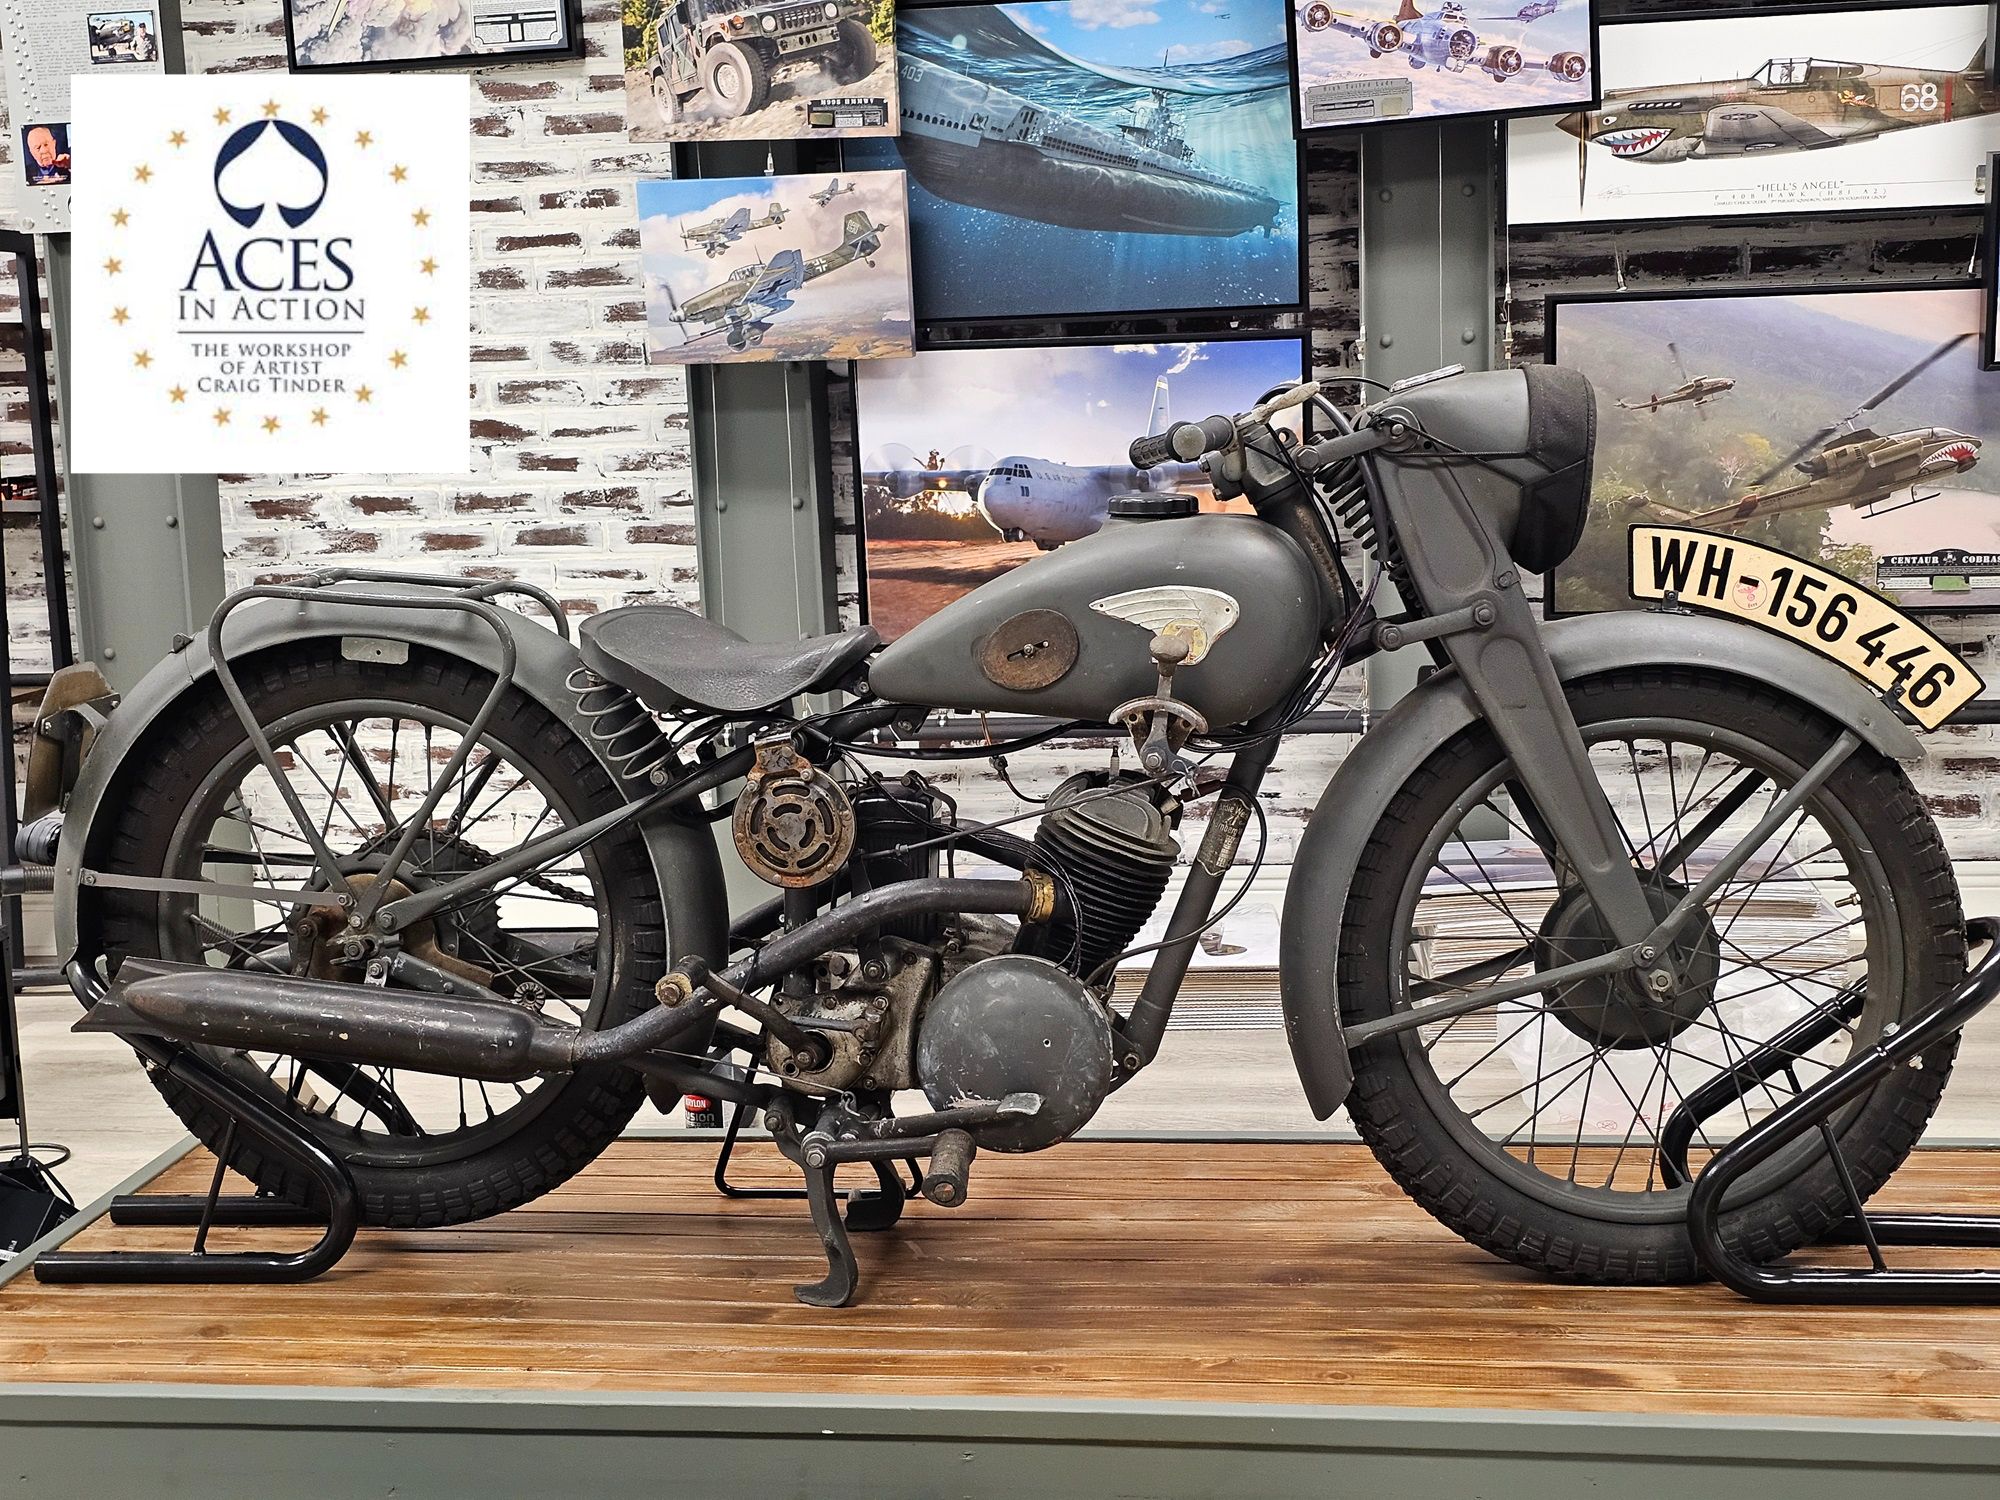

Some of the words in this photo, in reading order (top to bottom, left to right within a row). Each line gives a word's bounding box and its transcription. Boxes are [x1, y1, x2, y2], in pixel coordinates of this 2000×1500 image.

[901, 64, 924, 83] 403
[1900, 83, 1938, 112] 68
[1890, 555, 1939, 564] CENTAUR
[1855, 622, 1956, 708] 446
